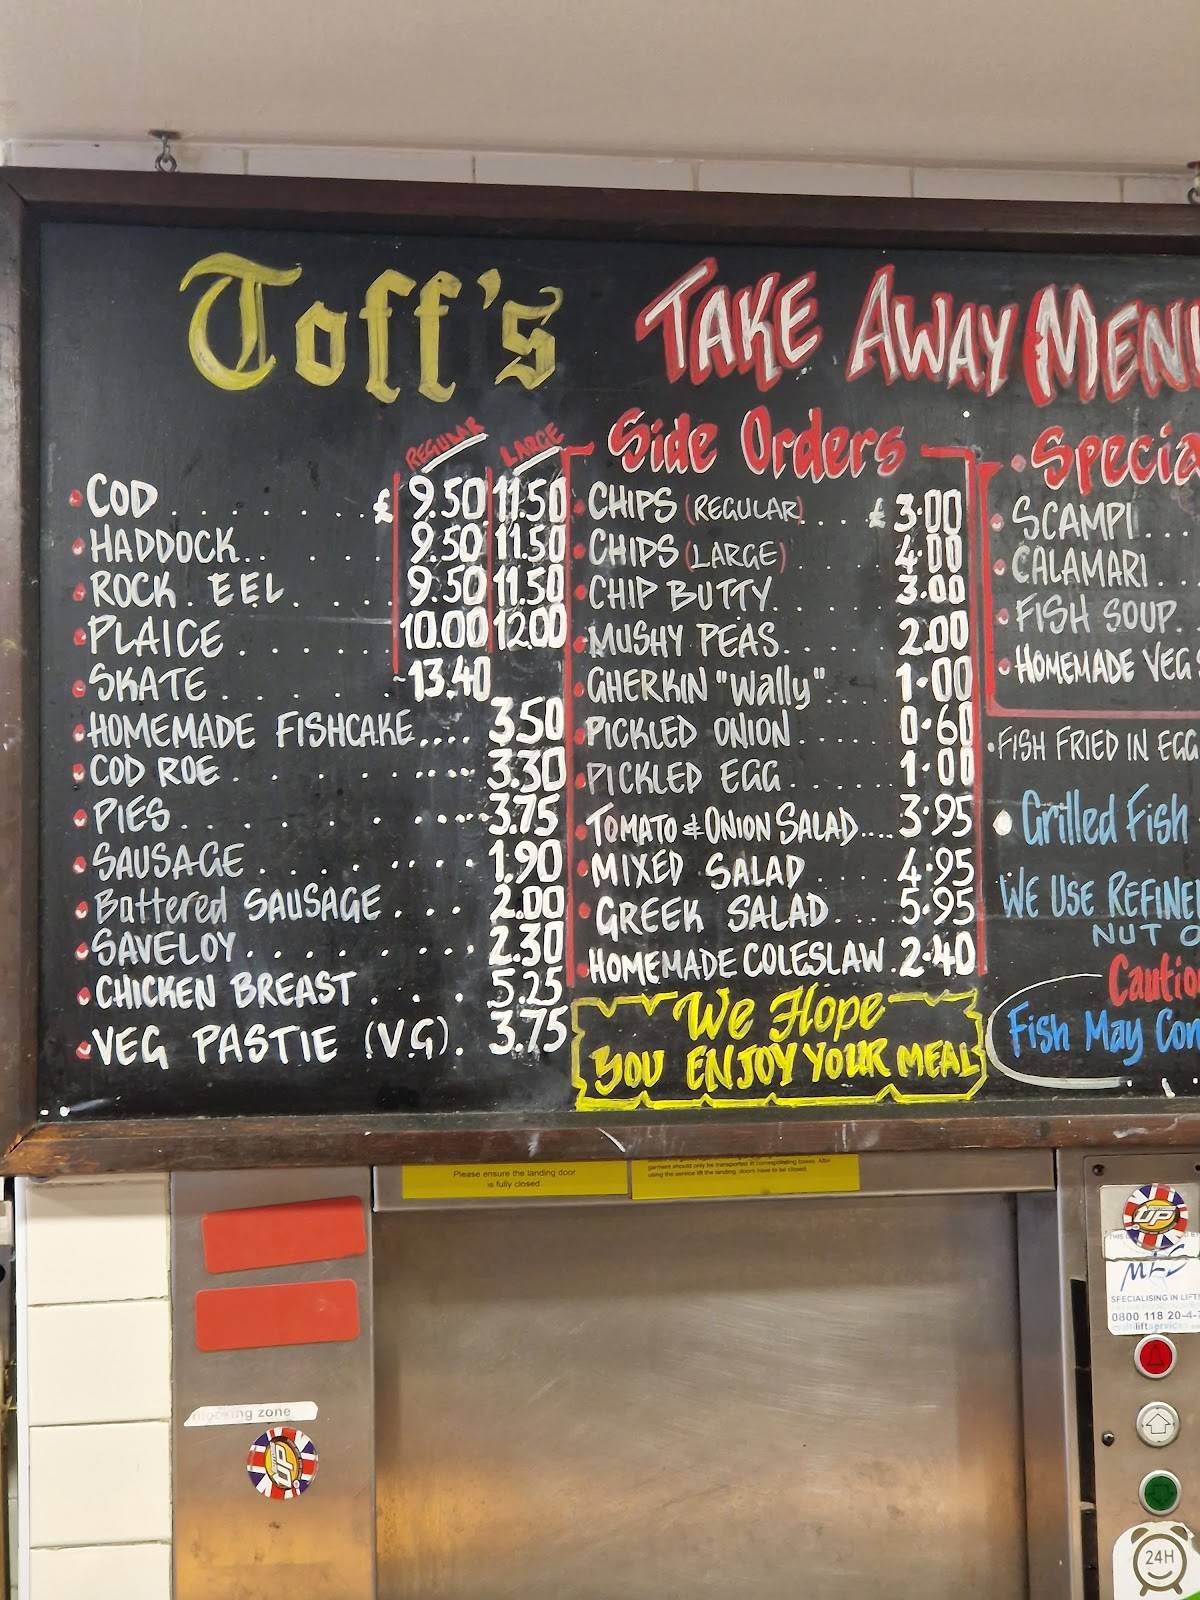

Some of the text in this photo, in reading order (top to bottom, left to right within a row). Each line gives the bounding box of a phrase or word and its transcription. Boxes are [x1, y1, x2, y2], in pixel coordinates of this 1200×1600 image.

[180, 252, 564, 403] Toff's
[636, 257, 822, 391] TAKE
[846, 264, 1019, 397] AWAY
[500, 422, 565, 468] LARGE
[607, 406, 906, 483] Side Orders
[87, 473, 567, 525] COD £ 9.50 11.50
[588, 481, 678, 523] CHIPS
[685, 494, 803, 526] (REGULAR)
[1012, 495, 1134, 541] SCAMPI
[89, 521, 567, 564] HADDOCK 9.50 11.50
[588, 528, 680, 568] CHIPS
[685, 540, 787, 574] (LARGE)
[89, 564, 565, 609] ROCK EEL 9.50 11.50
[1011, 544, 1148, 588] CALAMARI
[588, 574, 659, 610] CHIP
[665, 575, 773, 612] BUTTY
[1016, 592, 1177, 634] FISH SOUP
[88, 602, 568, 658] PLAICE 10.00 12.00
[588, 609, 969, 659] MUSHY PEAS 2.00
[88, 654, 492, 703] SKATE 13.40
[1014, 642, 1135, 684] HOMEMADE
[1142, 640, 1192, 682] VEG
[587, 665, 708, 705] GHERKIN
[87, 712, 256, 749] HOMEMADE
[275, 709, 413, 748] FISHCAKE
[583, 712, 697, 750] PICKLED
[715, 710, 790, 746] ONION
[998, 725, 1200, 762] FISH FRIED IN EGG
[89, 745, 566, 791] COD ROE 3.30
[585, 762, 702, 796] PICKLED
[721, 759, 782, 794] EGG
[93, 791, 560, 837] PIES 3.75
[704, 810, 771, 844] ONION
[777, 801, 860, 846] SALAD
[1021, 782, 1189, 846] Grilled Fish
[91, 840, 562, 884] SAUSAGE 1.90
[591, 852, 684, 887] MIXED
[705, 849, 806, 892] SALAD
[243, 883, 382, 921] SAUSAGE
[488, 884, 565, 920] 2.00
[999, 865, 1040, 918] WE
[1051, 873, 1095, 918] USE
[595, 901, 704, 937] GREEK
[727, 894, 829, 933] SALAD
[1092, 922, 1162, 947] NUT
[91, 921, 564, 967] SAVELOY 2.30
[588, 949, 738, 985] HOMEMADE
[741, 939, 886, 981] COLESLAW
[94, 967, 564, 1010] CHICKEN BREAST 5.25
[1108, 952, 1200, 1007] Cautio
[672, 982, 887, 1044] We Hope
[1007, 1000, 1072, 1059] Fish
[1084, 1008, 1144, 1067] May
[91, 1024, 169, 1070] VEG
[191, 1023, 339, 1065] PASTIE
[488, 1006, 568, 1055] 3.75
[591, 1037, 981, 1095] YOU ENJOY YOUR MEAL
[453, 1170, 481, 1178] Please
[512, 1168, 525, 1177] the
[527, 1167, 556, 1178] landing
[496, 1181, 512, 1189] fully
[1111, 1294, 1168, 1303] SPECIALISING
[1111, 1312, 1139, 1322] 0800
[1144, 1312, 1163, 1320] 118
[257, 1407, 291, 1417] zone
[1145, 1549, 1174, 1565] 24H
